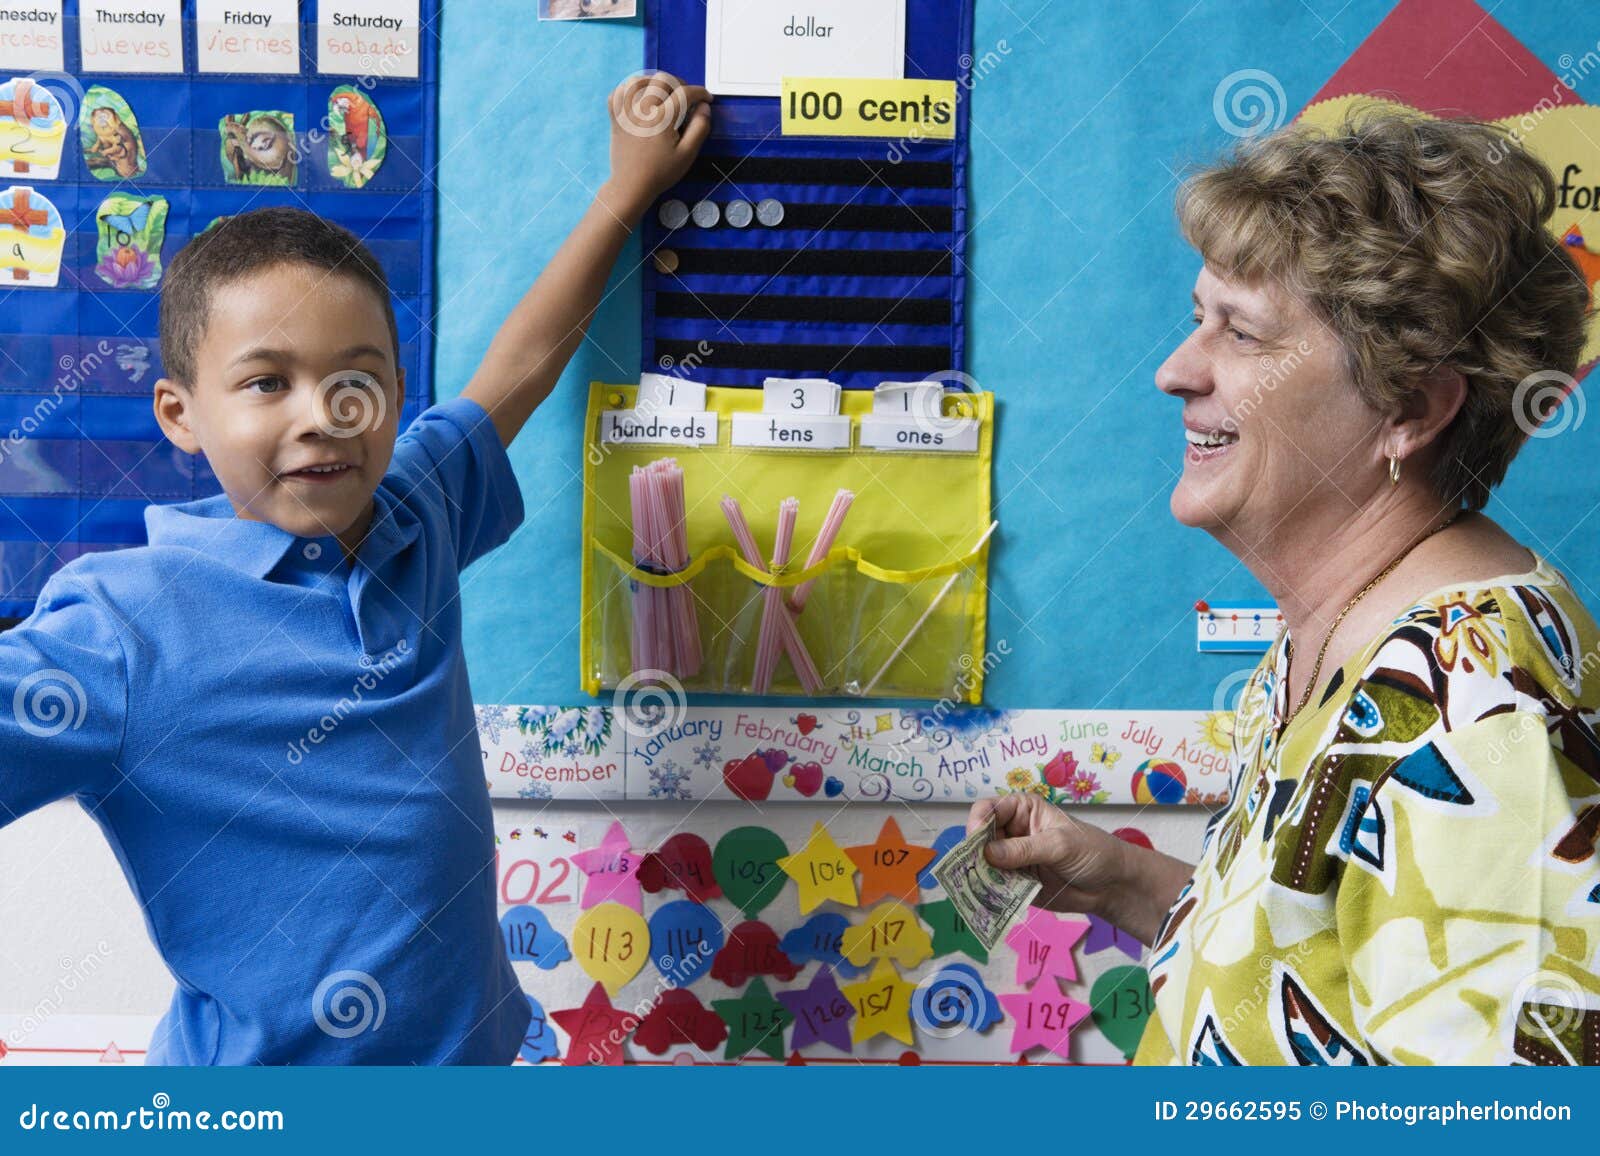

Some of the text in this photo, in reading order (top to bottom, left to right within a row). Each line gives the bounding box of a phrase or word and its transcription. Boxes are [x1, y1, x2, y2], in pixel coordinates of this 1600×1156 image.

[96, 9, 166, 26] Thursday
[224, 11, 272, 27] Friday
[333, 13, 403, 31] Saturday
[783, 16, 834, 38] dollar
[789, 90, 952, 125] 100 cents
[10, 126, 36, 154] 2
[106, 224, 132, 249] 10
[668, 385, 675, 406] 1
[790, 388, 805, 410] 3
[903, 391, 909, 412] 1
[612, 415, 706, 440] hundreds
[768, 417, 814, 442] tens
[896, 427, 944, 445] ones
[1206, 622, 1217, 636] 0
[1253, 622, 1261, 636] 2
[633, 713, 1230, 783] January February March April May June July Augu
[499, 751, 617, 783] December
[873, 849, 909, 867] 107
[730, 860, 773, 884] 105
[809, 859, 845, 886] 106
[509, 921, 539, 957] 112
[590, 927, 633, 962] 113
[667, 927, 703, 960] 114
[871, 920, 904, 952] 117
[1028, 939, 1051, 978] 119
[801, 999, 847, 1037] 126
[1026, 1003, 1070, 1030] 129
